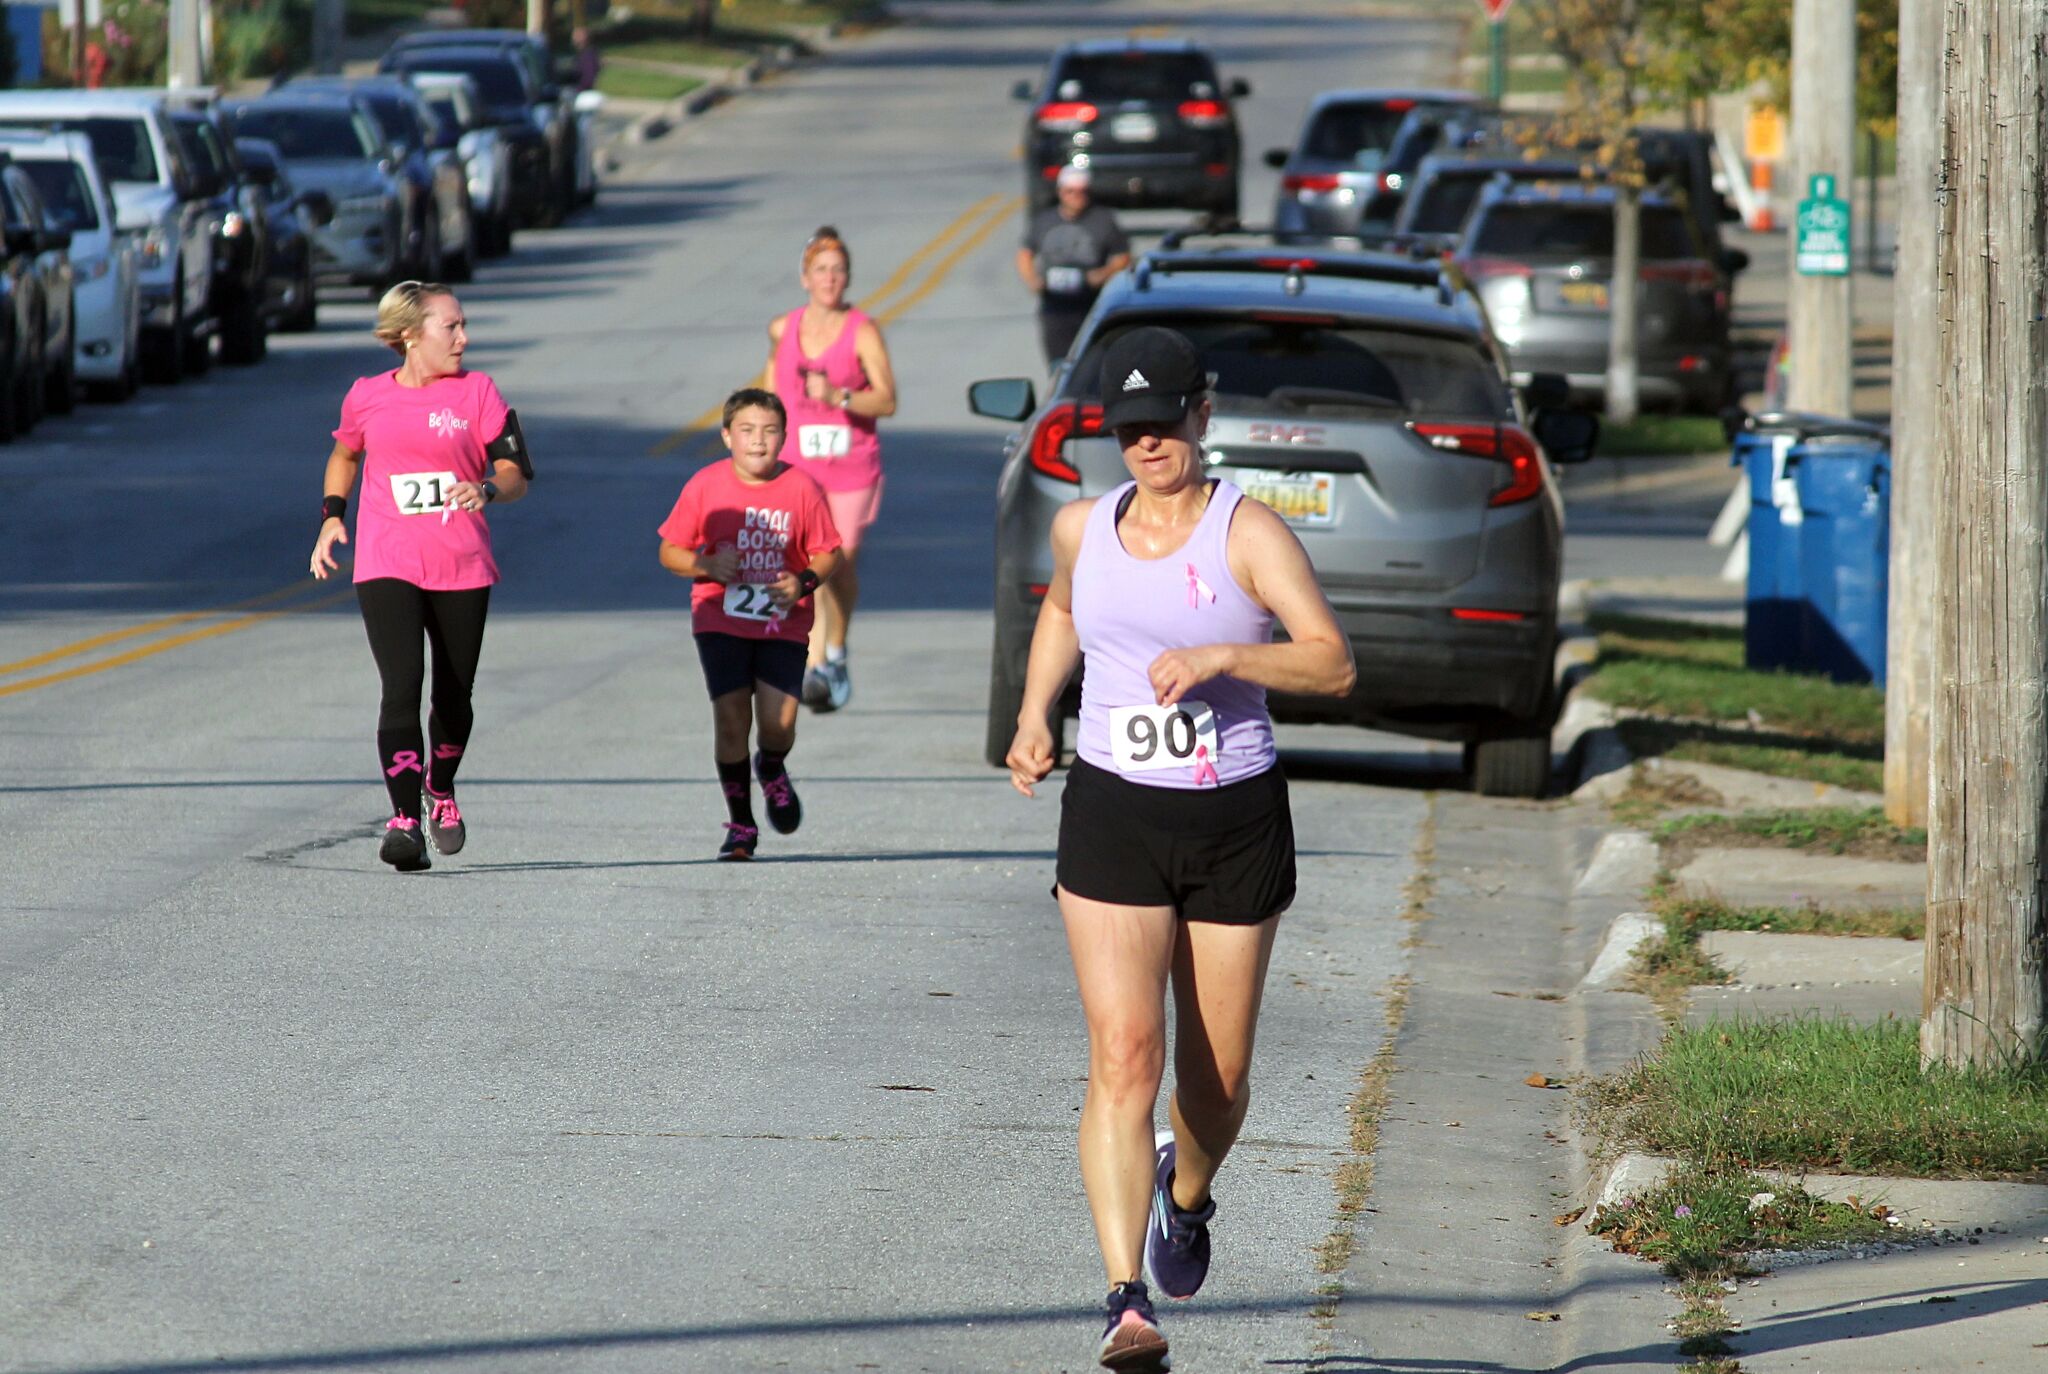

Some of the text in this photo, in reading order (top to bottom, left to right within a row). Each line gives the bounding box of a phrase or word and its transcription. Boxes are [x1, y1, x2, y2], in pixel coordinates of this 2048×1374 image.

[808, 430, 839, 453] 47
[403, 477, 445, 509] 21
[737, 529, 788, 550] BOYS
[1127, 710, 1197, 762] 90
